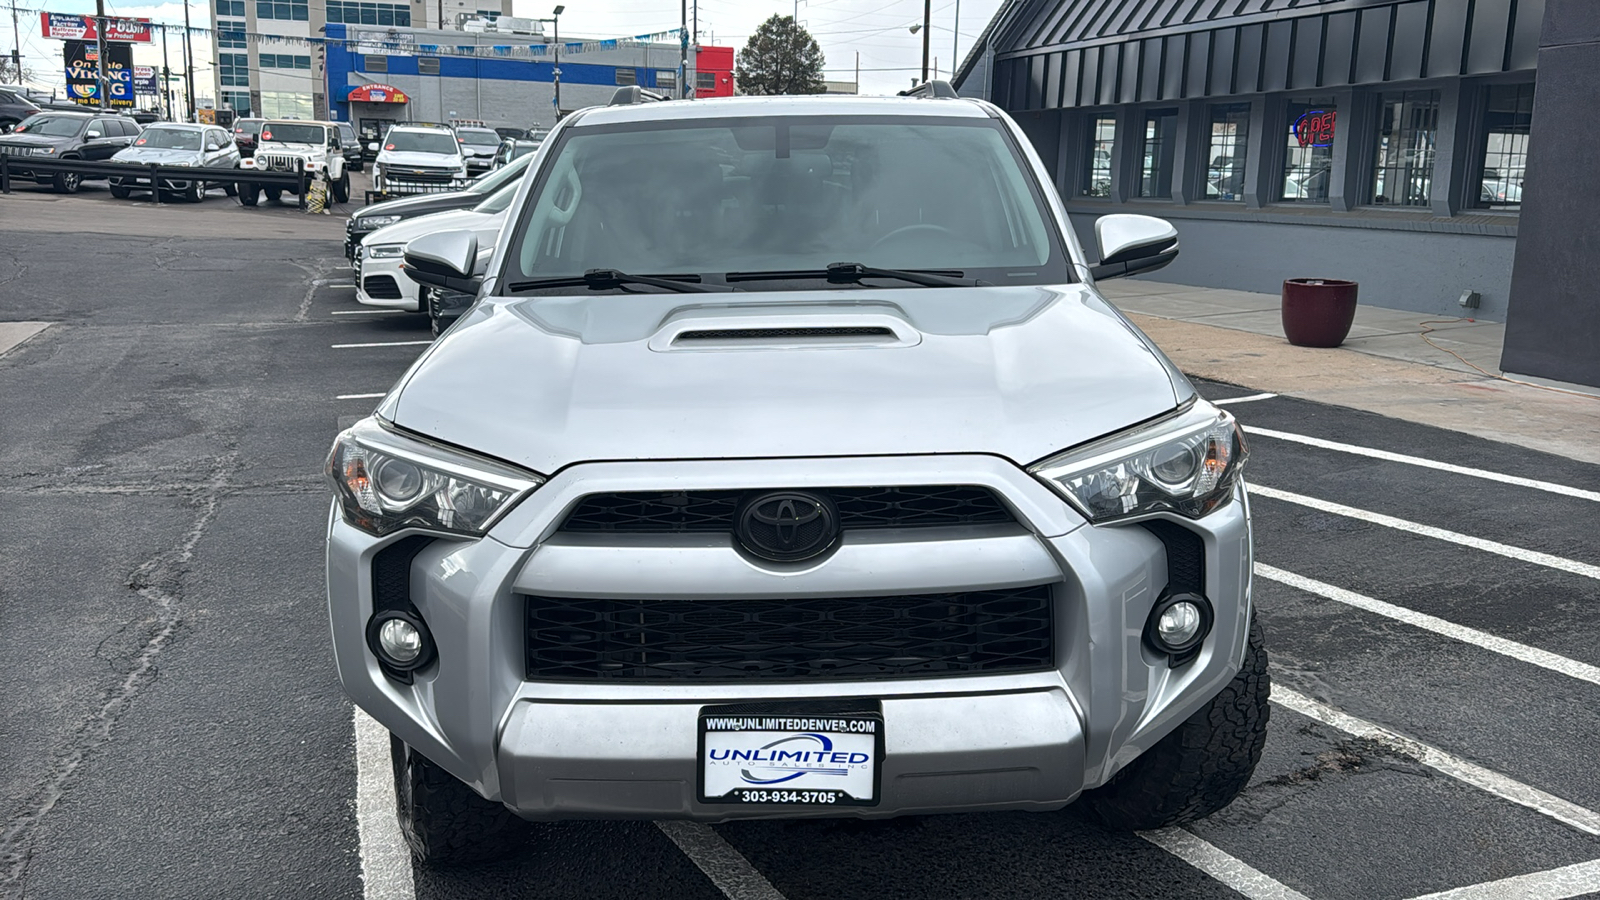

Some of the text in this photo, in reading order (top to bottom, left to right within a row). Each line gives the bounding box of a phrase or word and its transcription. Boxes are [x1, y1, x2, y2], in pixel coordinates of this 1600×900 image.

[72, 60, 91, 69] On
[67, 67, 130, 81] VIKNG
[362, 84, 394, 93] ENTRANCE
[110, 98, 133, 107] elivery
[706, 718, 875, 733] WWWUNLIMITEDDENVER.COM
[709, 749, 869, 764] UNLIMITED
[741, 790, 836, 804] 303-934-3705
